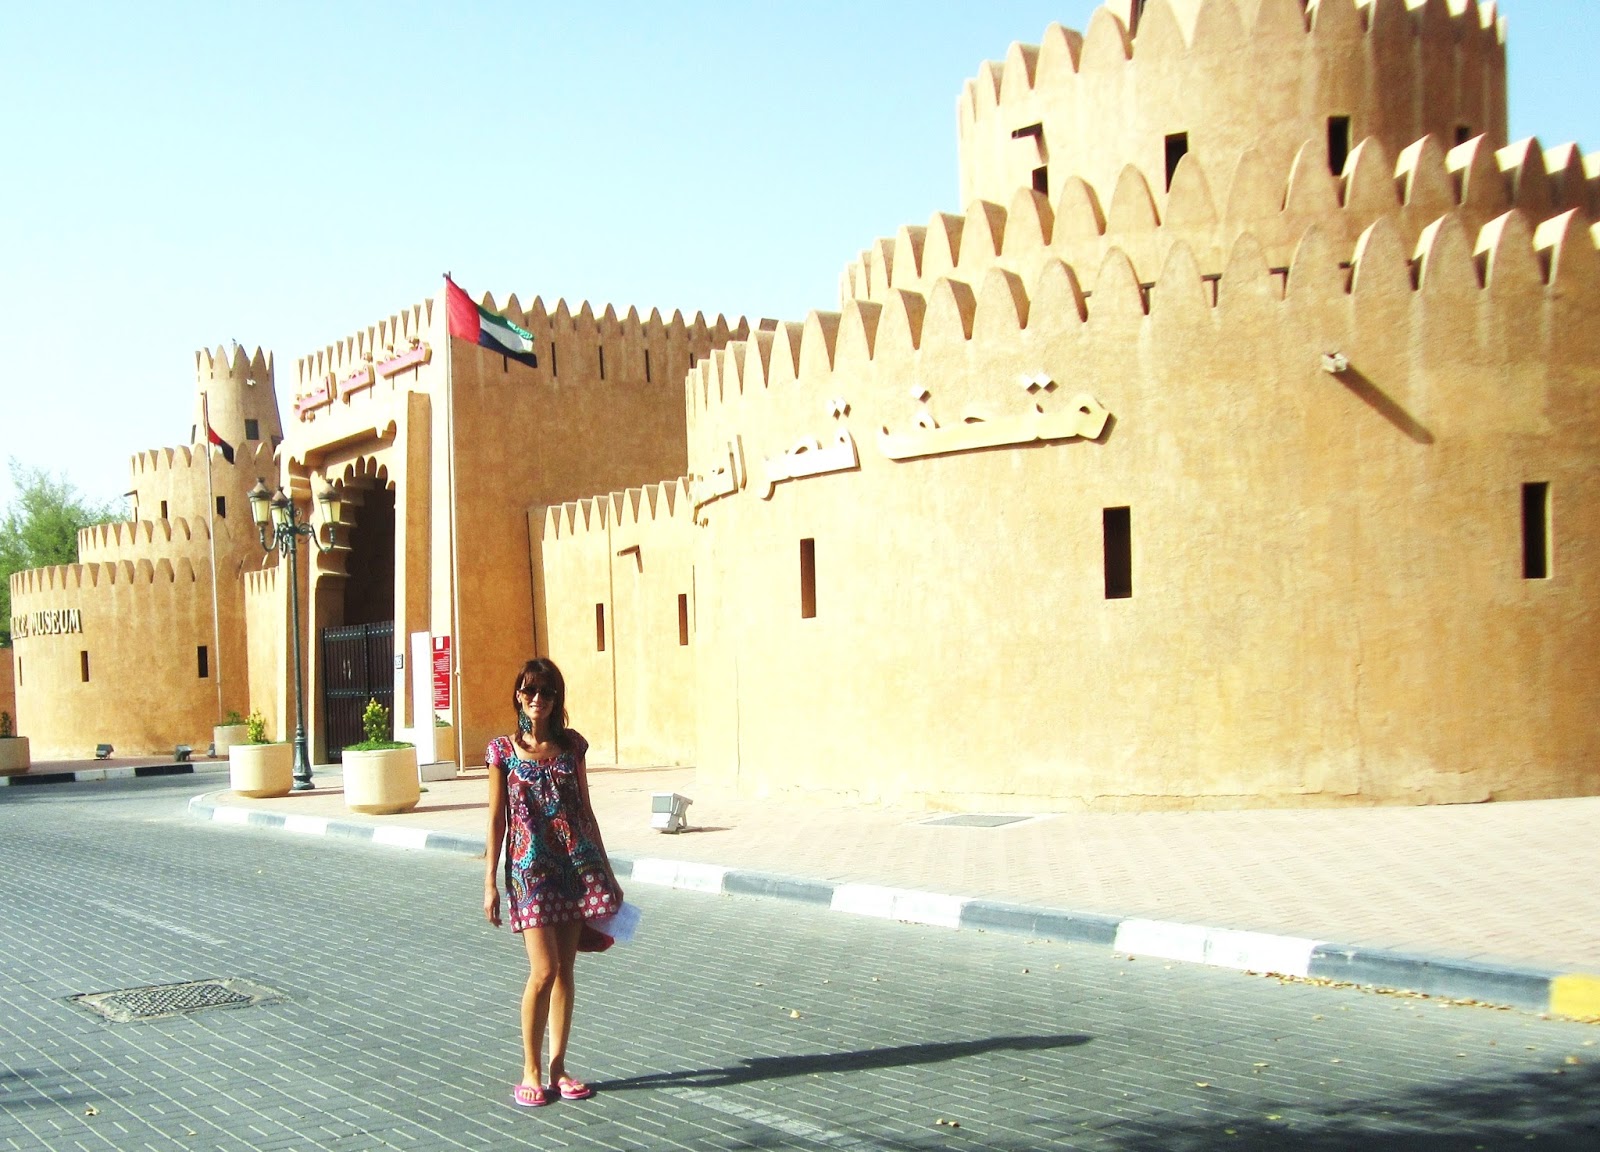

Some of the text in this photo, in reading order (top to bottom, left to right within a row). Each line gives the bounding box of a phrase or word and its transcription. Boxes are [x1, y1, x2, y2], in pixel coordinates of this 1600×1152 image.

[760, 398, 860, 500] قصر
[876, 373, 1112, 461] متحف
[32, 608, 83, 636] MUSEUM
